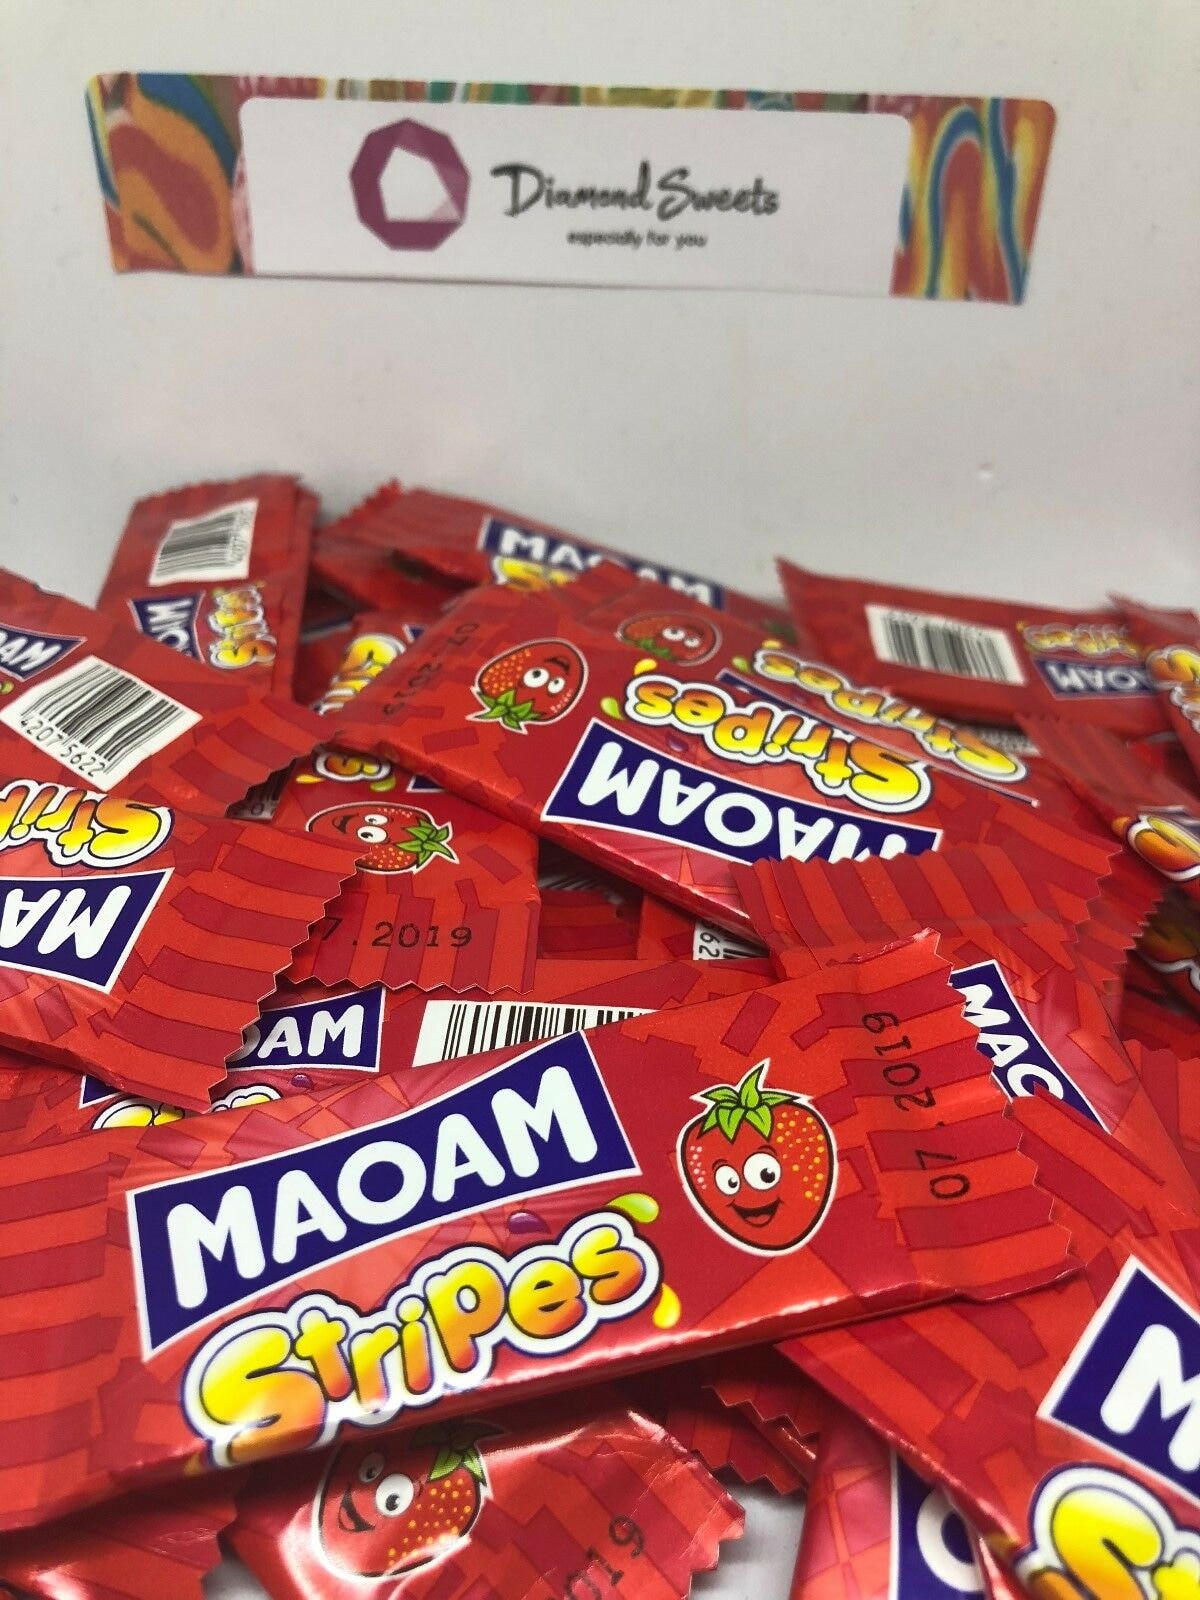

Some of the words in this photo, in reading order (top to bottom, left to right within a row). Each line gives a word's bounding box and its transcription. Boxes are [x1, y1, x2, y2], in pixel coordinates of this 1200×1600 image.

[491, 161, 653, 218] Diamond
[656, 168, 781, 221] Sweets
[567, 228, 643, 248] especially
[645, 228, 671, 246] for
[675, 233, 708, 248] you
[59, 742, 108, 779] 5622
[625, 674, 933, 813] Stripes
[753, 648, 1028, 782] Stripes
[166, 1065, 598, 1310] MAOAM
[184, 1209, 662, 1469] Stripes
